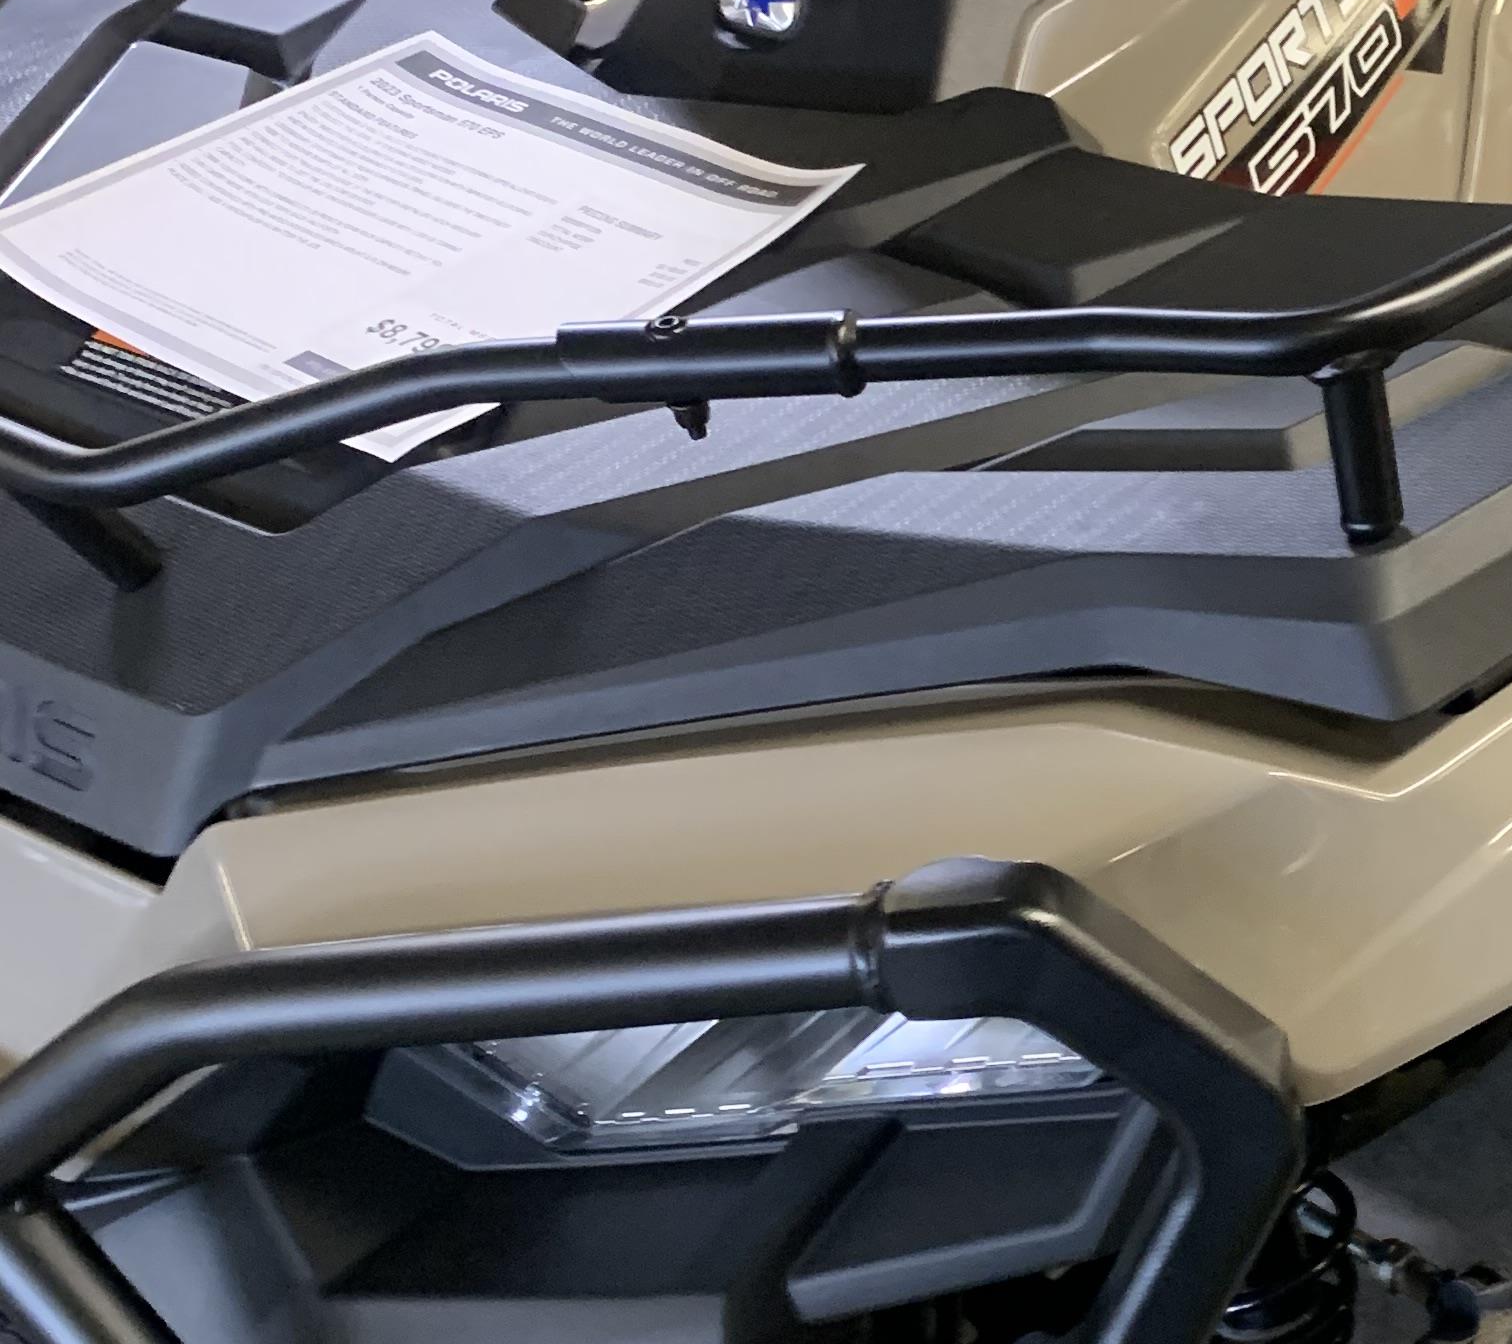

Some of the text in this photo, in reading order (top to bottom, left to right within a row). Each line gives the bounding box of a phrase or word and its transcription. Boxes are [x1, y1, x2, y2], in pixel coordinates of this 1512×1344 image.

[428, 69, 530, 113] POLARIS
[1248, 2, 1402, 197] 570
[550, 115, 578, 131] THE
[578, 126, 629, 149] WORLD
[628, 144, 686, 170] LEADER
[705, 173, 738, 187] OFF
[366, 317, 460, 355] $8,79
